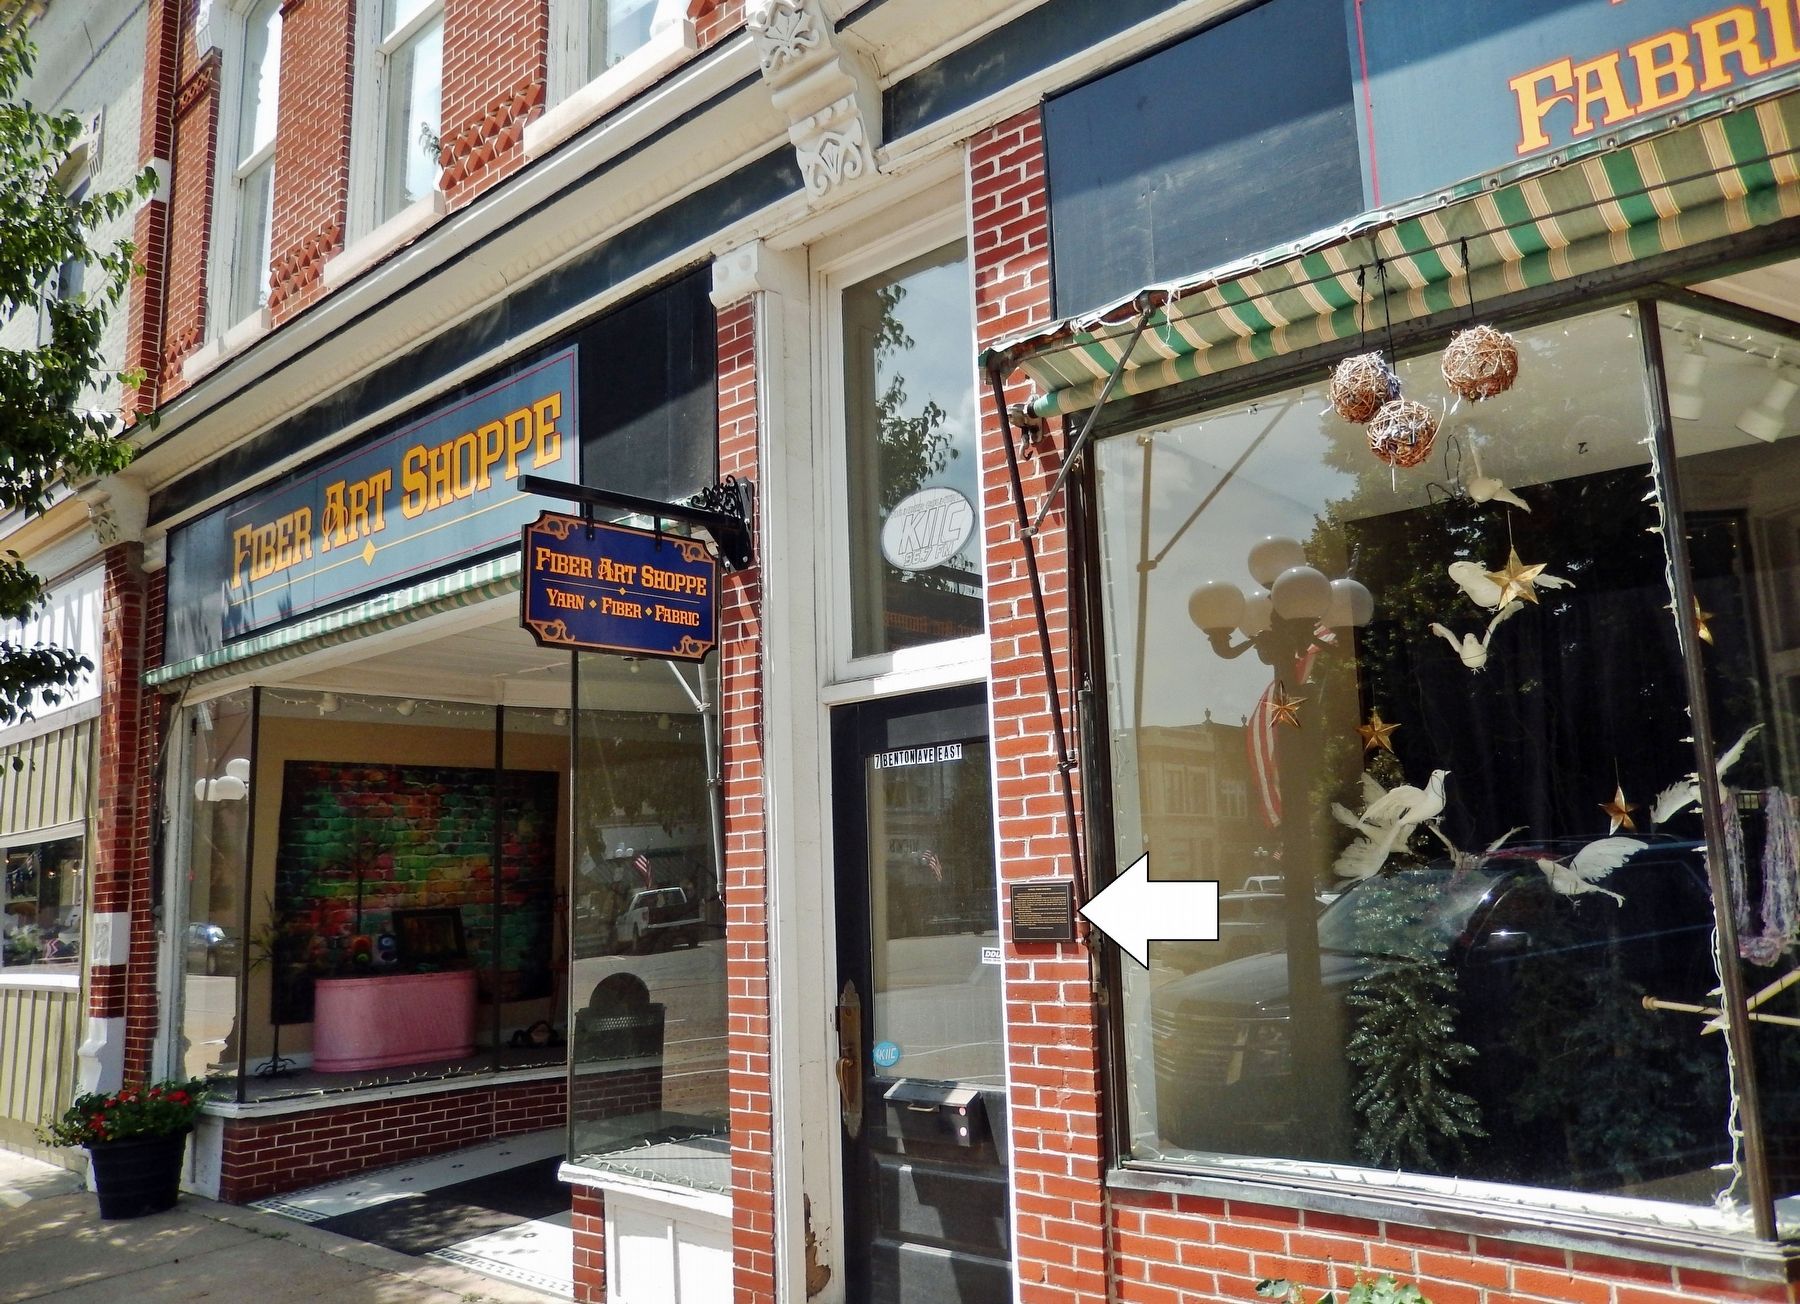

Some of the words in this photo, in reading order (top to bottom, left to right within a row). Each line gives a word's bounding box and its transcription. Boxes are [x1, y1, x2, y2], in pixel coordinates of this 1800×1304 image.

[1508, 0, 1800, 155] FABRI
[231, 505, 313, 591] FIBER
[321, 468, 392, 554] ART
[402, 391, 562, 520] SHOPPE
[898, 498, 967, 555] KIIC
[535, 546, 593, 579] FIBER
[598, 557, 637, 585] ART
[641, 565, 707, 597] SHOPPE
[546, 588, 585, 611] YARN
[601, 596, 642, 619] FIBER
[654, 604, 700, 627] FABRIC
[874, 755, 880, 769] 7
[883, 750, 915, 767] BENTON
[917, 748, 934, 763] AVE
[938, 744, 961, 761] EAST
